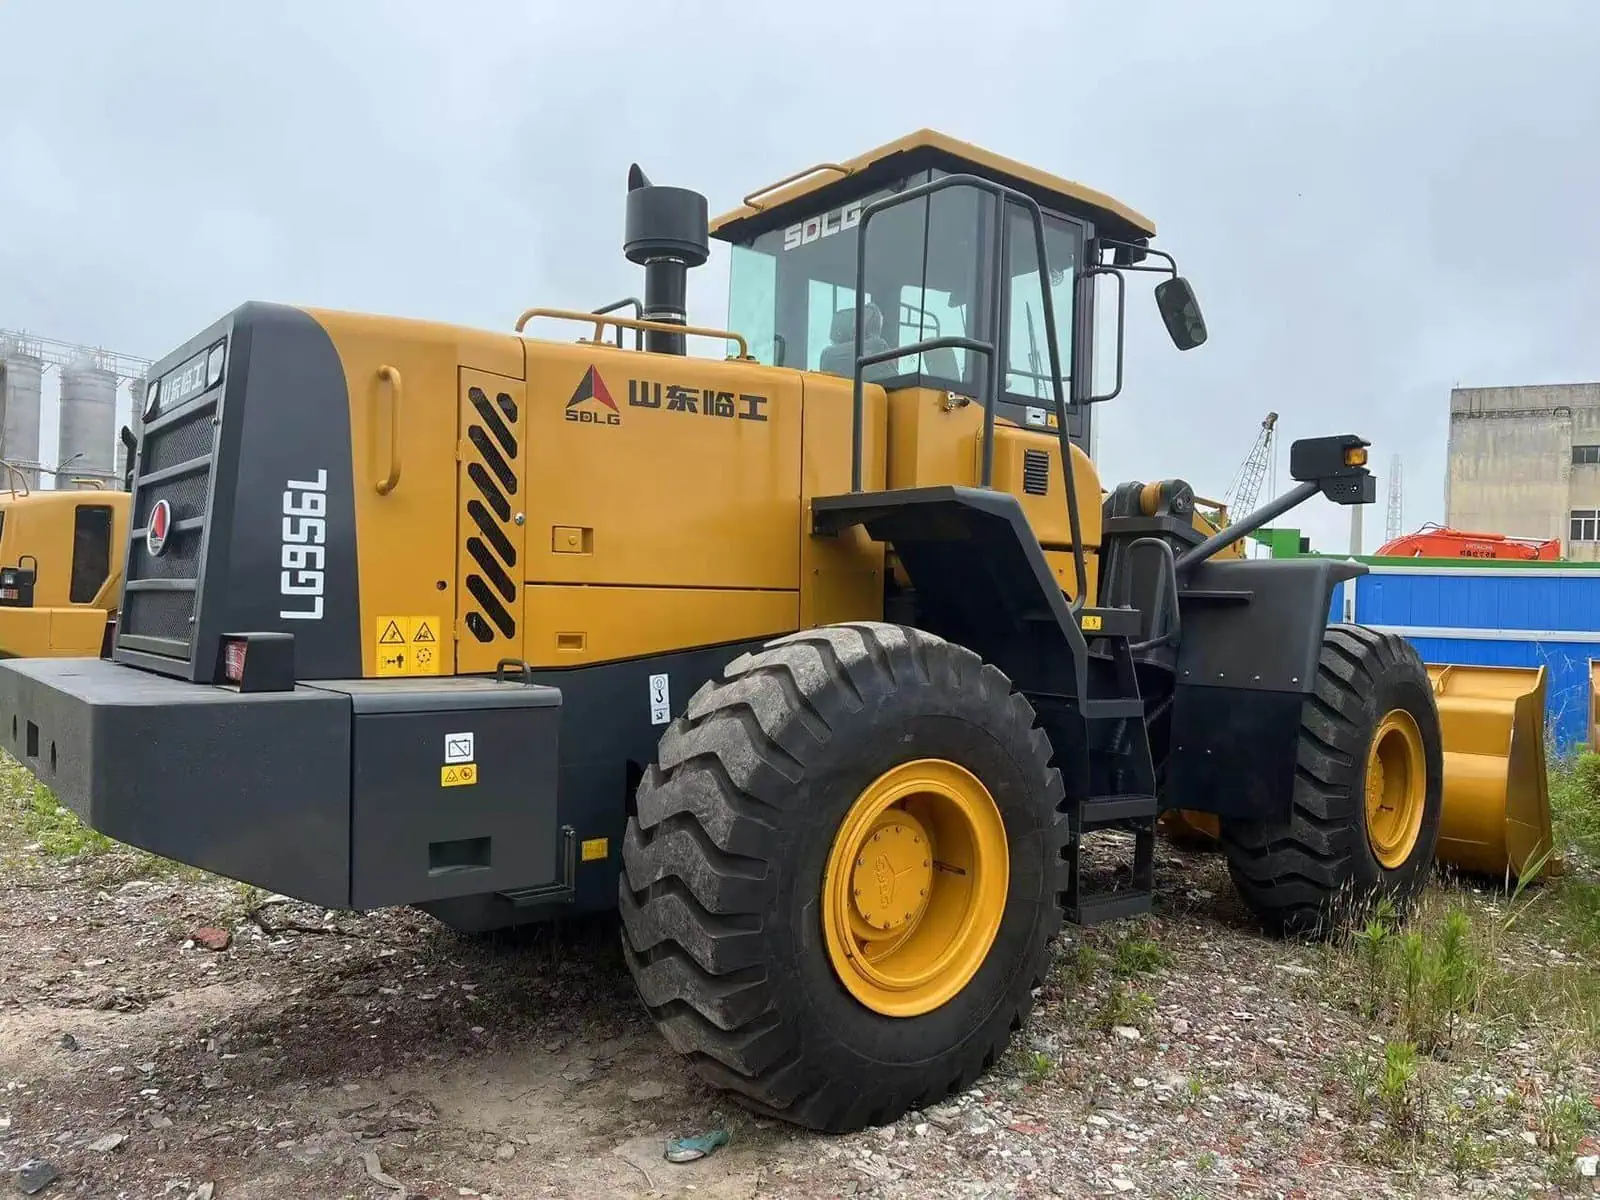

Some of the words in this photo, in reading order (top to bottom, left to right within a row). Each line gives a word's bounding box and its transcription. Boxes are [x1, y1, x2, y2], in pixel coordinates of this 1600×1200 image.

[783, 200, 861, 251] SDLG
[565, 409, 621, 425] SDLG
[628, 379, 767, 422] 山东临工
[279, 468, 328, 620] LG956L
